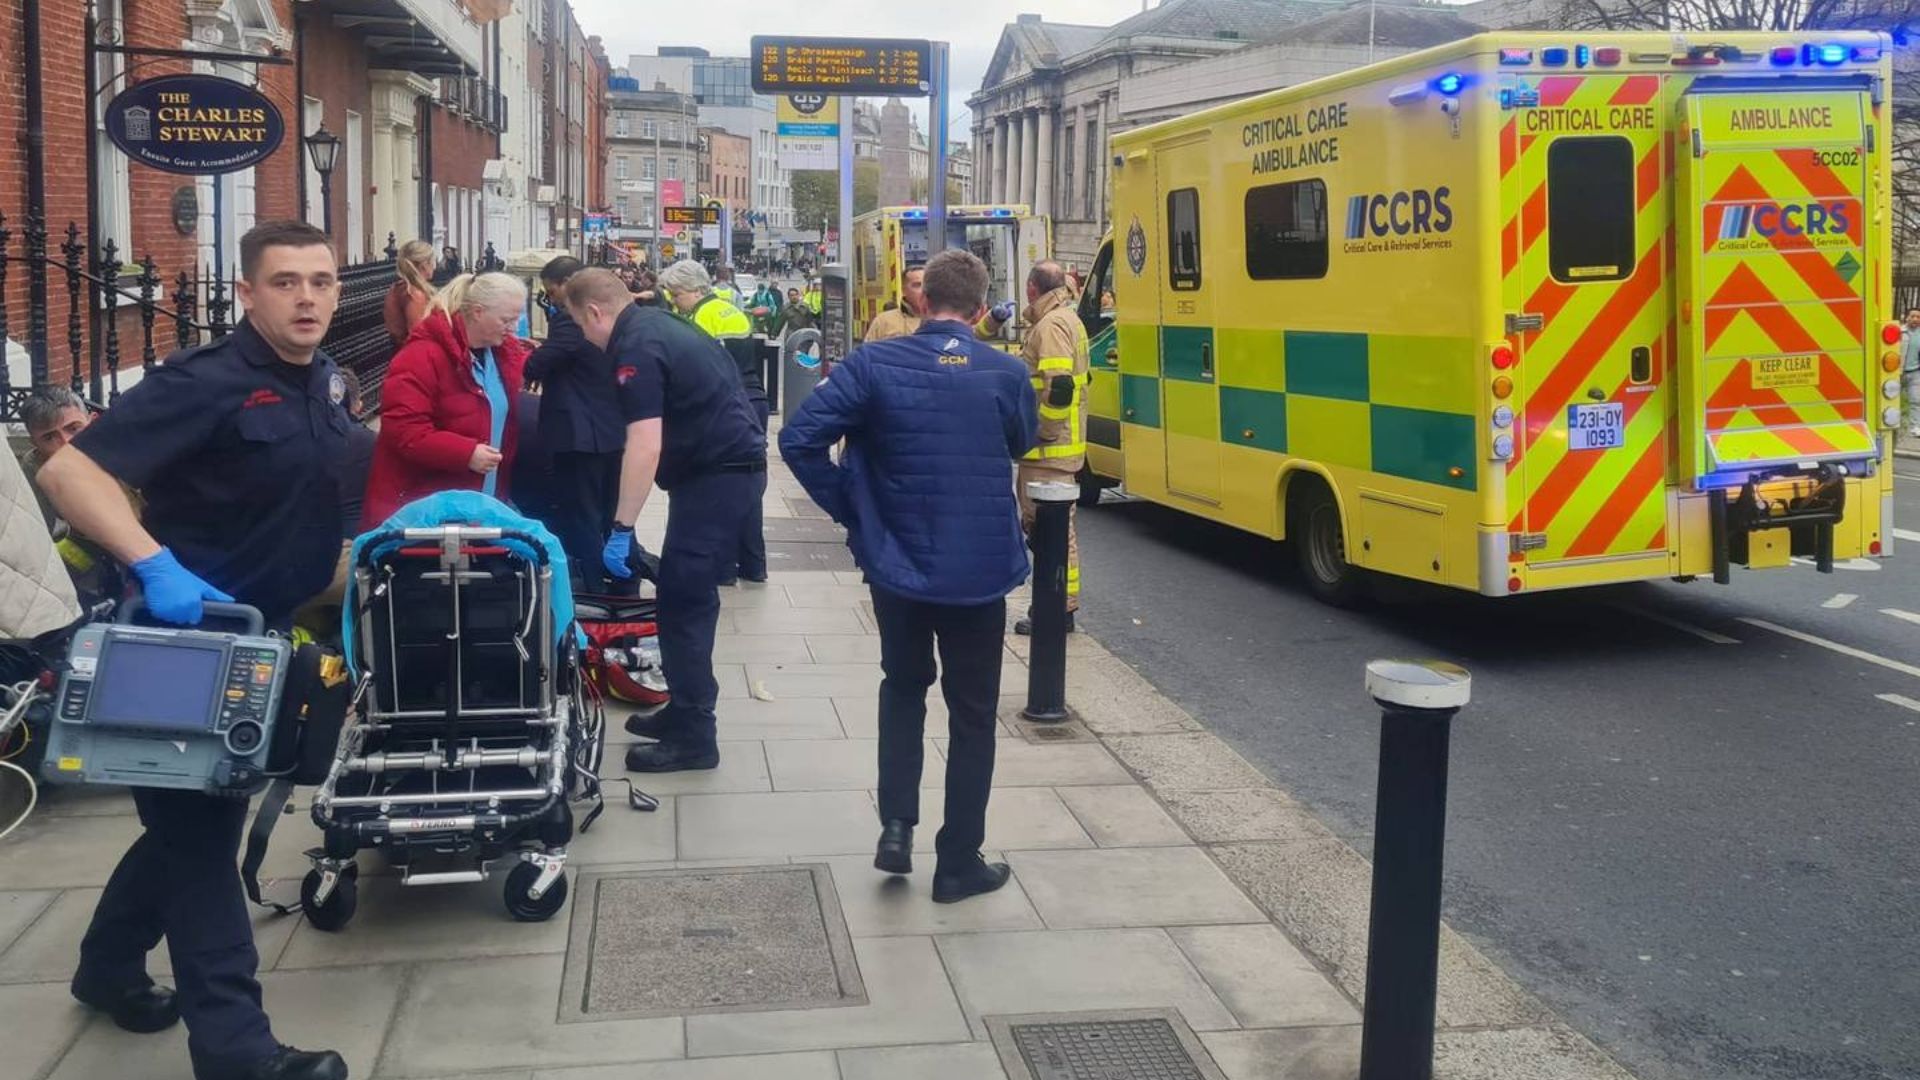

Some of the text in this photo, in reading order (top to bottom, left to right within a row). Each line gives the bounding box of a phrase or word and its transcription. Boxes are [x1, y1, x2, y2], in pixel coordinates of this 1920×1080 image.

[815, 57, 849, 65] Parnell
[815, 75, 850, 83] Parnell
[159, 92, 191, 104] THE
[158, 107, 266, 124] CHARLES
[1526, 107, 1654, 131] CRITICAL CARE
[1730, 107, 1833, 131] AMBULANCE
[1242, 102, 1348, 147] CRITICAL CARE
[159, 126, 267, 142] STEWART
[174, 157, 197, 167] Guest
[201, 149, 258, 167] Accommodation
[1252, 137, 1339, 175] AMBULANCE
[1812, 151, 1859, 167] 5CC02
[1369, 186, 1453, 237] CCRS
[1752, 202, 1849, 237] CCRS
[1343, 241, 1366, 254] Critical
[1367, 241, 1383, 253] Care
[1422, 238, 1452, 250] Services
[1718, 241, 1748, 250] Critical
[1749, 240, 1769, 249] Care
[938, 355, 968, 365] GCM
[1760, 357, 1811, 373] KEEP CLEAR
[1579, 409, 1622, 428] 231-OY
[1586, 428, 1616, 446] 1093
